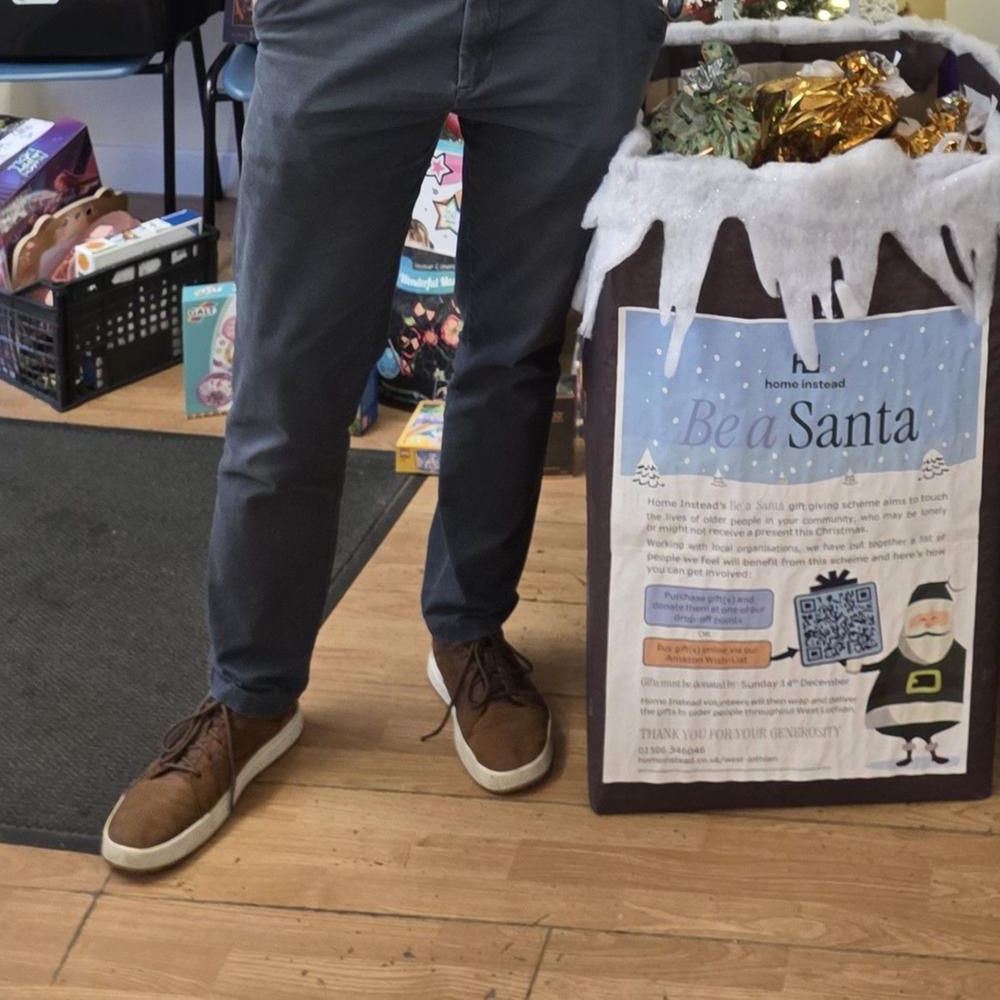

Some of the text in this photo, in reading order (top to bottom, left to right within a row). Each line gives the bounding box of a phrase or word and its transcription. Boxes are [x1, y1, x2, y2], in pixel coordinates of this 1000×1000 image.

[765, 378, 846, 389] home instead
[677, 398, 919, 449] Be a Santa
[648, 497, 677, 508] Home
[680, 499, 726, 511] Instead's
[842, 499, 880, 509] scheme
[883, 497, 907, 506] aims
[909, 496, 919, 505] to
[921, 493, 948, 502] touch
[646, 513, 662, 521] the
[665, 513, 687, 522] lives
[690, 514, 699, 523] of
[704, 515, 726, 524] older
[731, 517, 761, 527] people
[765, 516, 774, 524] in
[778, 517, 799, 527] your
[861, 513, 879, 521] who
[883, 511, 901, 520] may
[907, 510, 917, 518] be
[921, 508, 946, 517] lonely
[646, 524, 656, 532] or
[659, 525, 688, 535] might
[690, 527, 705, 536] not
[709, 528, 745, 537] receive
[755, 529, 793, 538] present
[795, 527, 813, 537] this
[647, 540, 684, 550] Working
[688, 543, 708, 551] with
[712, 543, 733, 552] local
[823, 543, 845, 551] have
[849, 541, 864, 551] put
[869, 538, 906, 549] together
[647, 553, 680, 563] people
[701, 556, 720, 565] feel
[723, 557, 740, 566] will
[743, 558, 778, 567] benefit
[781, 558, 805, 567] from
[809, 557, 827, 566] this
[830, 555, 869, 565] scheme
[871, 553, 890, 562] and
[926, 548, 945, 557] how
[646, 565, 665, 575] you
[667, 567, 685, 575] can
[687, 567, 703, 577] get
[664, 591, 705, 602] Purchase
[737, 594, 755, 603] and
[652, 602, 684, 611] donate
[686, 603, 709, 612] them
[721, 606, 739, 614] one
[665, 654, 704, 664] Amazon
[741, 680, 776, 690] Sunday
[800, 679, 849, 687] December
[668, 698, 701, 706] Instead
[640, 708, 655, 716] the
[640, 726, 840, 740] THANK YOU FOR YOUR GENEROSITY
